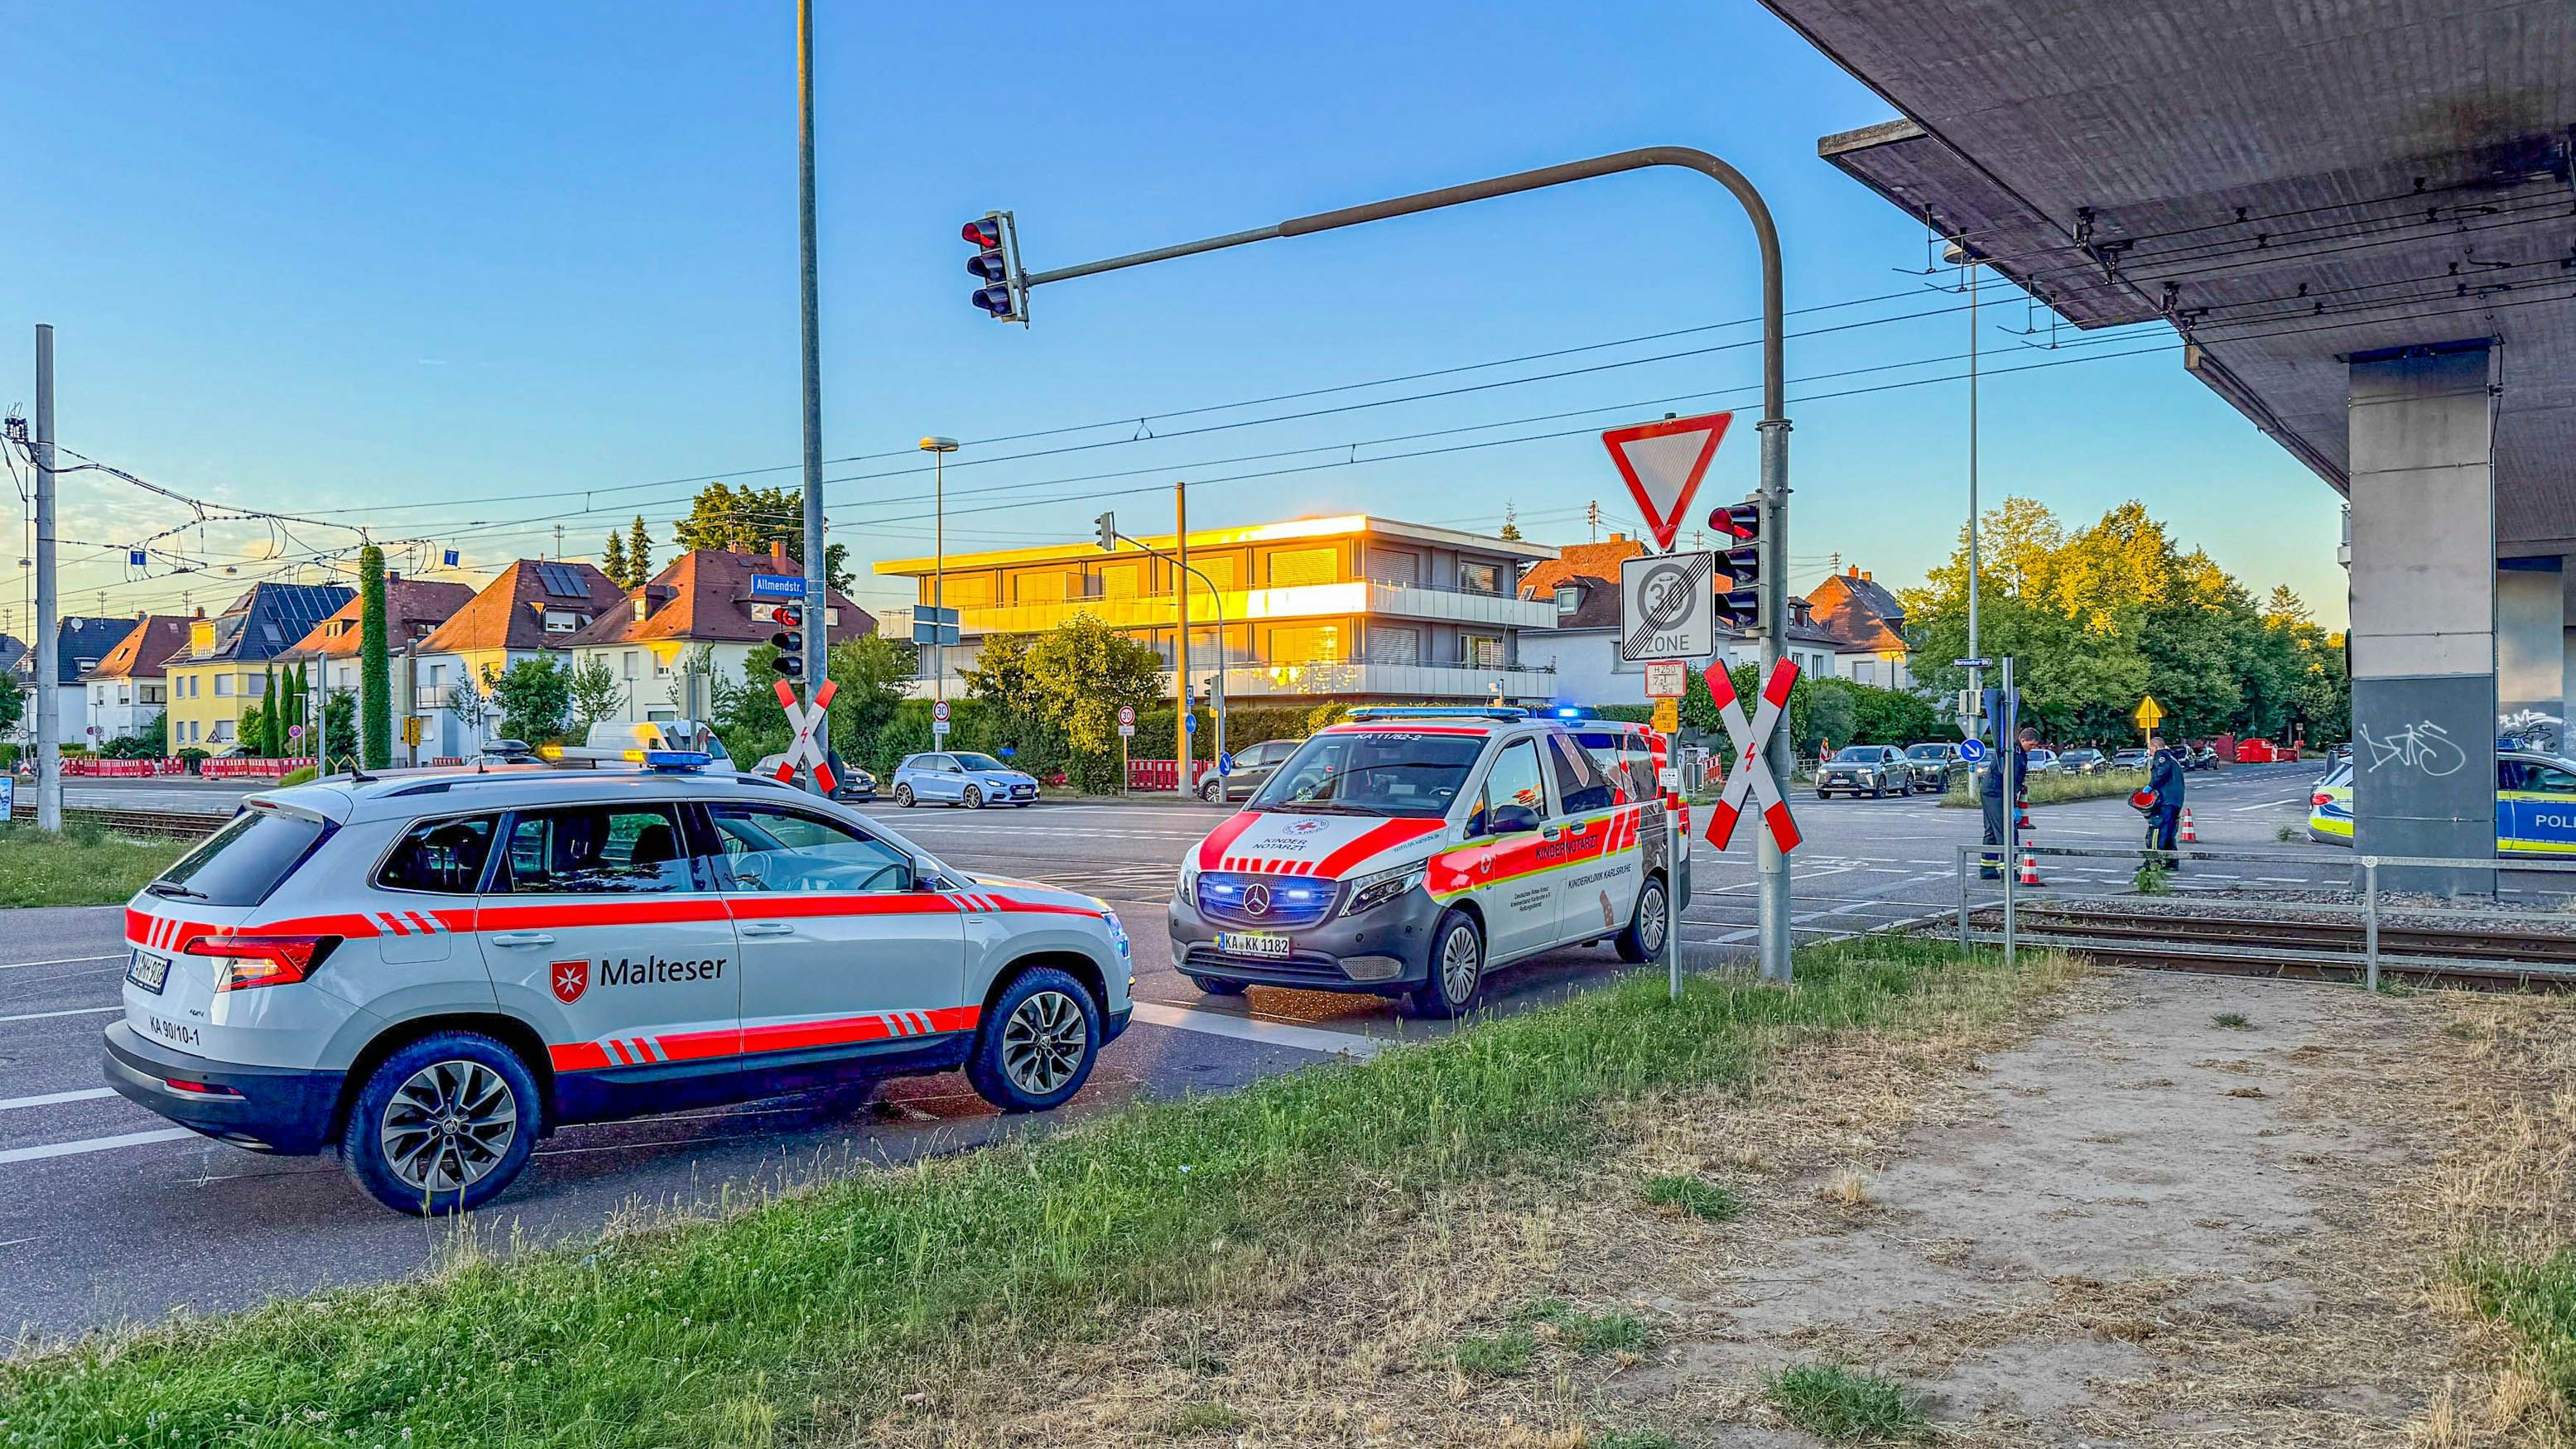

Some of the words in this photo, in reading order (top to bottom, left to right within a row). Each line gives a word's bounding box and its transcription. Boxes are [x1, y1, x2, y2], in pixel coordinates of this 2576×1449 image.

[757, 578, 802, 593] Allmendstr.
[1644, 634, 1690, 652] ZONE
[937, 706, 946, 716] 30
[1122, 711, 1131, 720] 30
[1253, 844, 1307, 852] NOTARZT
[1264, 837, 1307, 845] KINDER
[1225, 935, 1238, 950] KA
[1245, 936, 1259, 951] KK
[1261, 938, 1288, 954] 1182
[600, 955, 727, 986] Malteser
[150, 1014, 163, 1036] KA
[163, 1020, 200, 1046] 90/10-1
